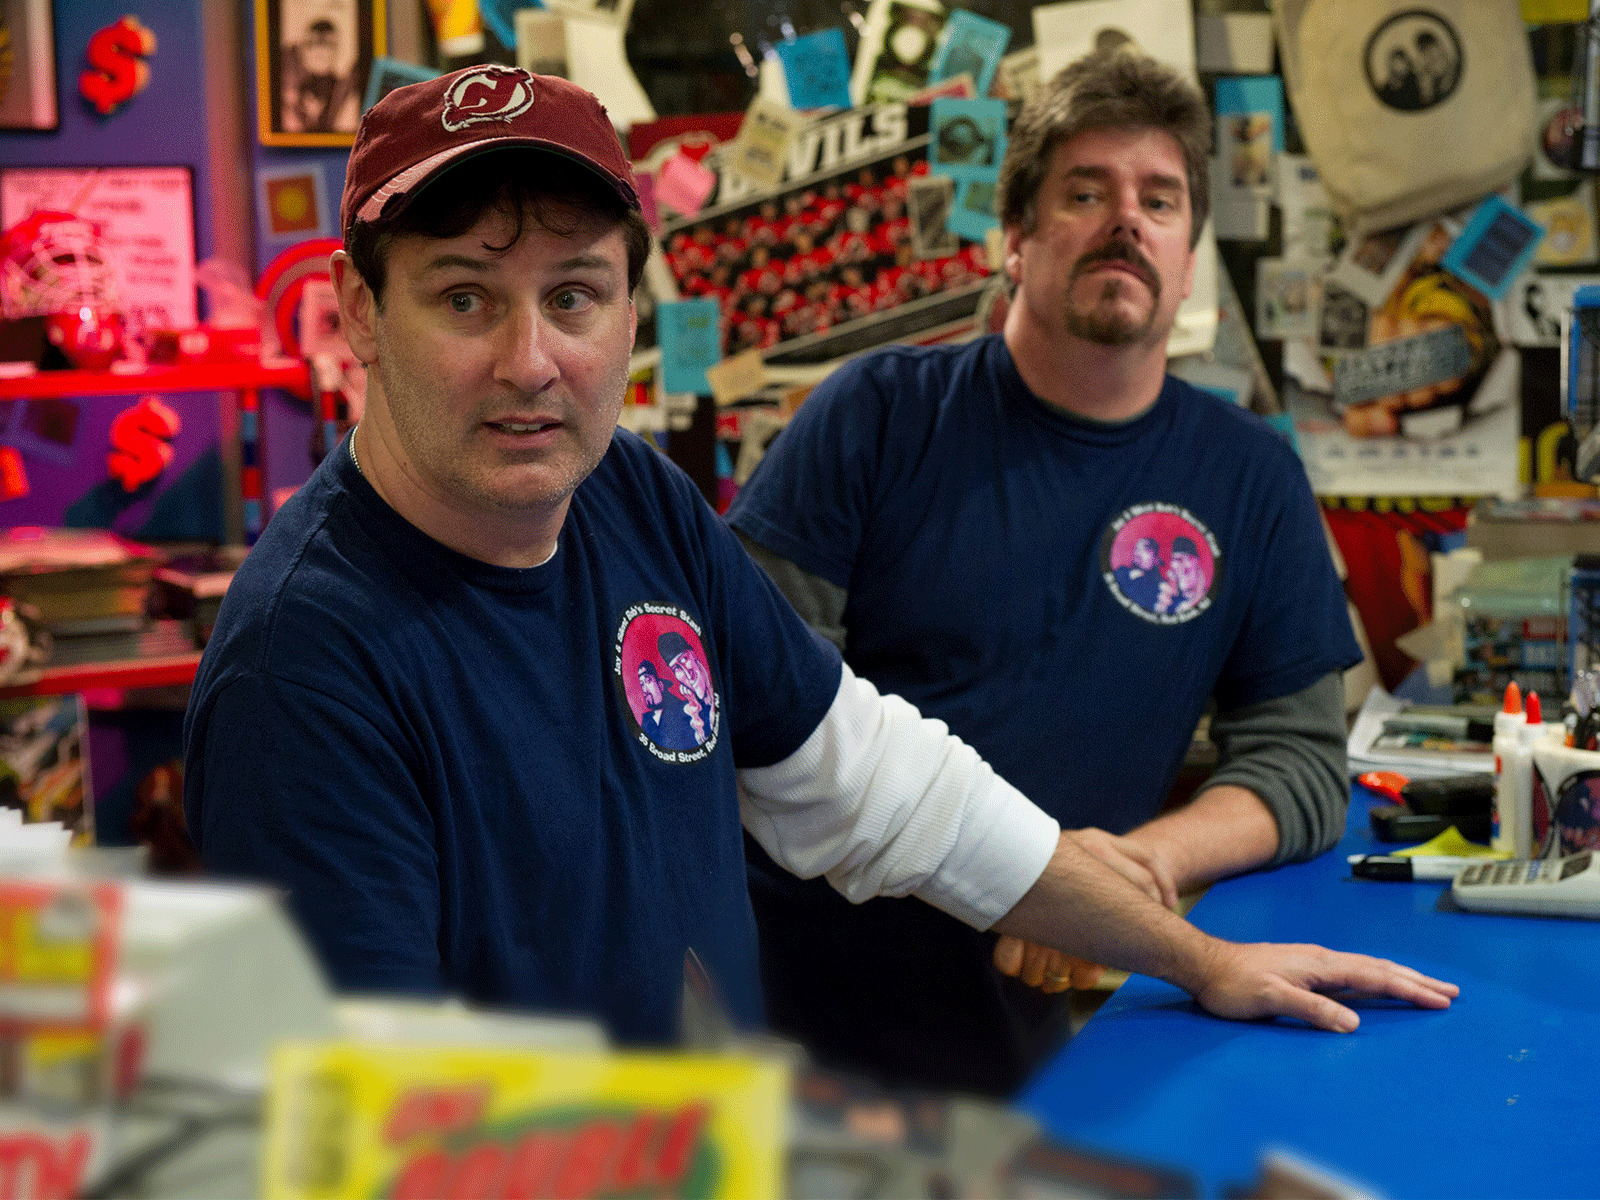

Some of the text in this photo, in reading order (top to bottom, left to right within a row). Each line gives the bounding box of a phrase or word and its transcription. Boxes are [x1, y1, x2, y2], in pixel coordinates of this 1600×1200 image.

[717, 104, 908, 206] DVILS
[643, 602, 677, 616] Secret
[679, 610, 702, 637] Stash
[649, 742, 676, 762] Broad
